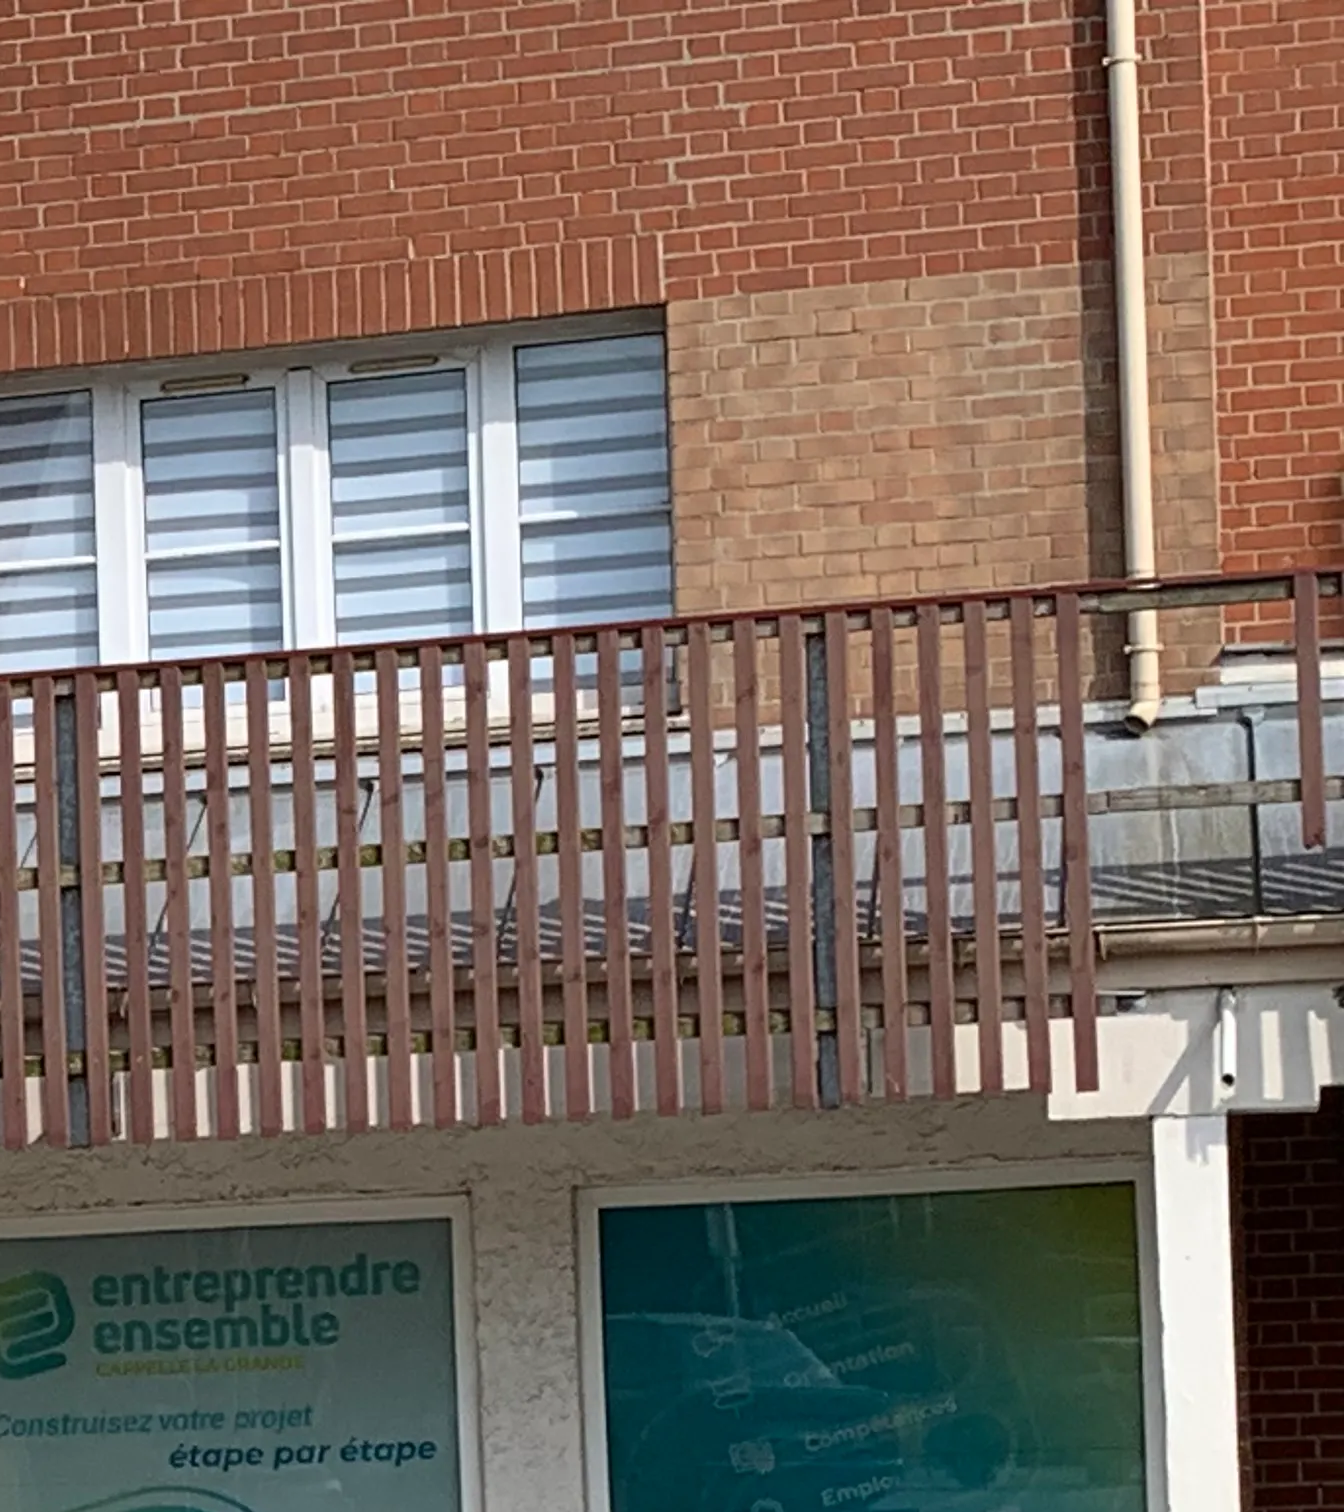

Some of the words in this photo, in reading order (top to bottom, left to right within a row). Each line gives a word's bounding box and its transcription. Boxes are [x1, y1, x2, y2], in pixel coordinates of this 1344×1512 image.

[92, 1253, 421, 1312] entreprendre
[93, 1303, 341, 1355] ensemble
[158, 1407, 226, 1432] votre
[233, 1404, 314, 1436] projet
[169, 1442, 264, 1472] étape
[274, 1444, 331, 1471] par
[340, 1436, 438, 1467] étape
